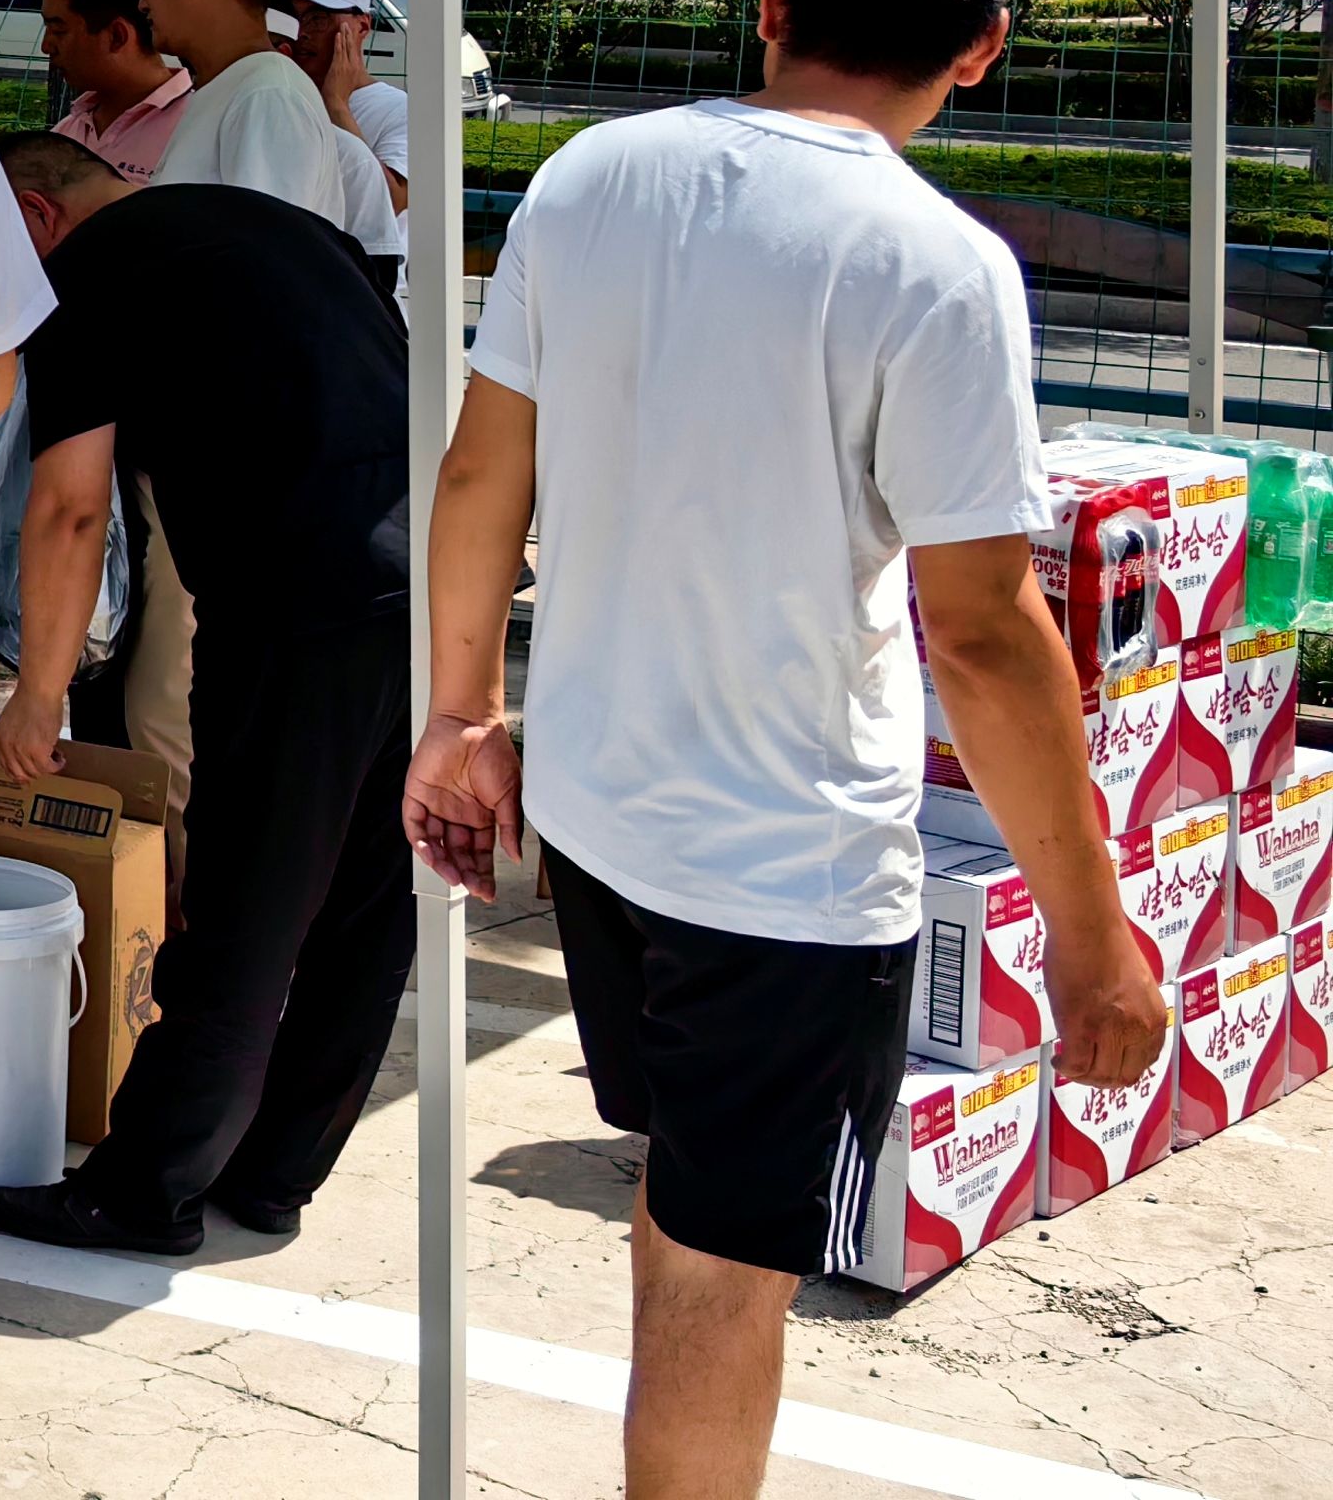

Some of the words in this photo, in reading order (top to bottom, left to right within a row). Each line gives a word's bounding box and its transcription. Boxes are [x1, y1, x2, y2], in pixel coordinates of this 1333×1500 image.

[1159, 513, 1229, 571] 娃哈哈
[1206, 668, 1279, 725] 娃哈哈
[1087, 703, 1159, 766] 娃哈哈
[1256, 818, 1320, 868] Wahaha
[1137, 855, 1211, 921] 娃哈哈
[1205, 996, 1271, 1062] 娃哈哈
[933, 1120, 1020, 1187] Wahaha
